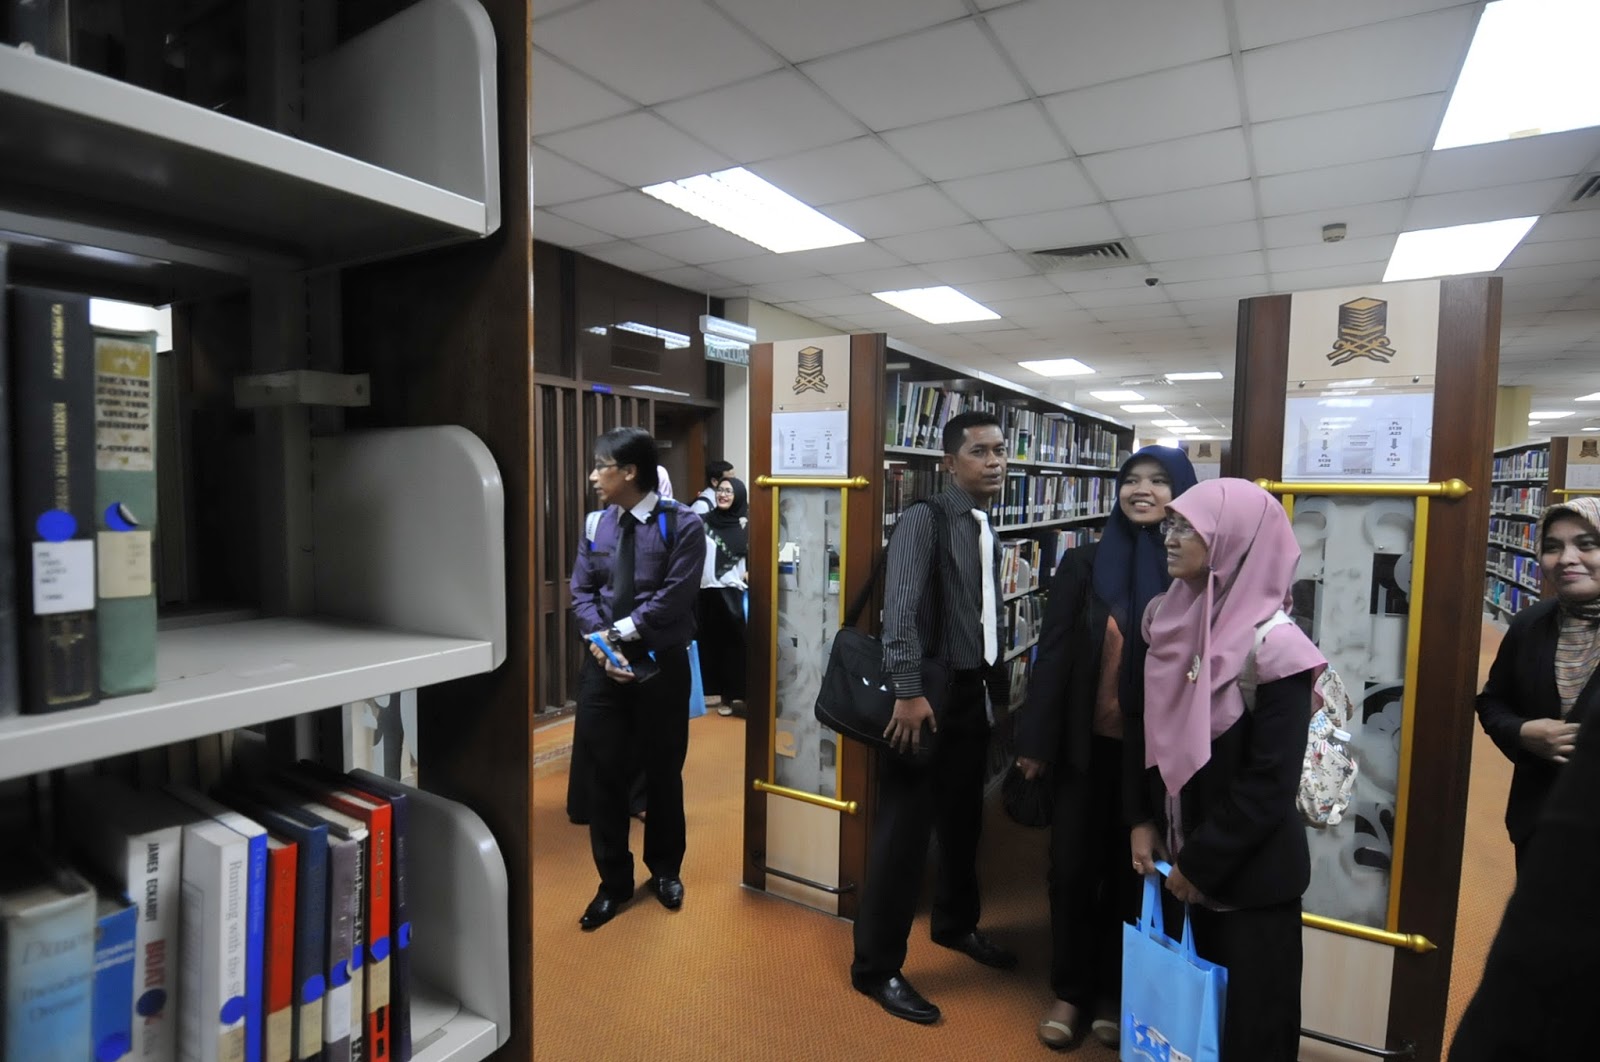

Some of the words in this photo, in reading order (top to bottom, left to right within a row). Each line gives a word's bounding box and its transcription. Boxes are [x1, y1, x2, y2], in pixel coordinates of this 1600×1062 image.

[147, 843, 159, 873] JAMES
[145, 878, 158, 922] ECKARDT
[226, 860, 242, 919] Running
[228, 922, 241, 954] with
[228, 956, 241, 978] the
